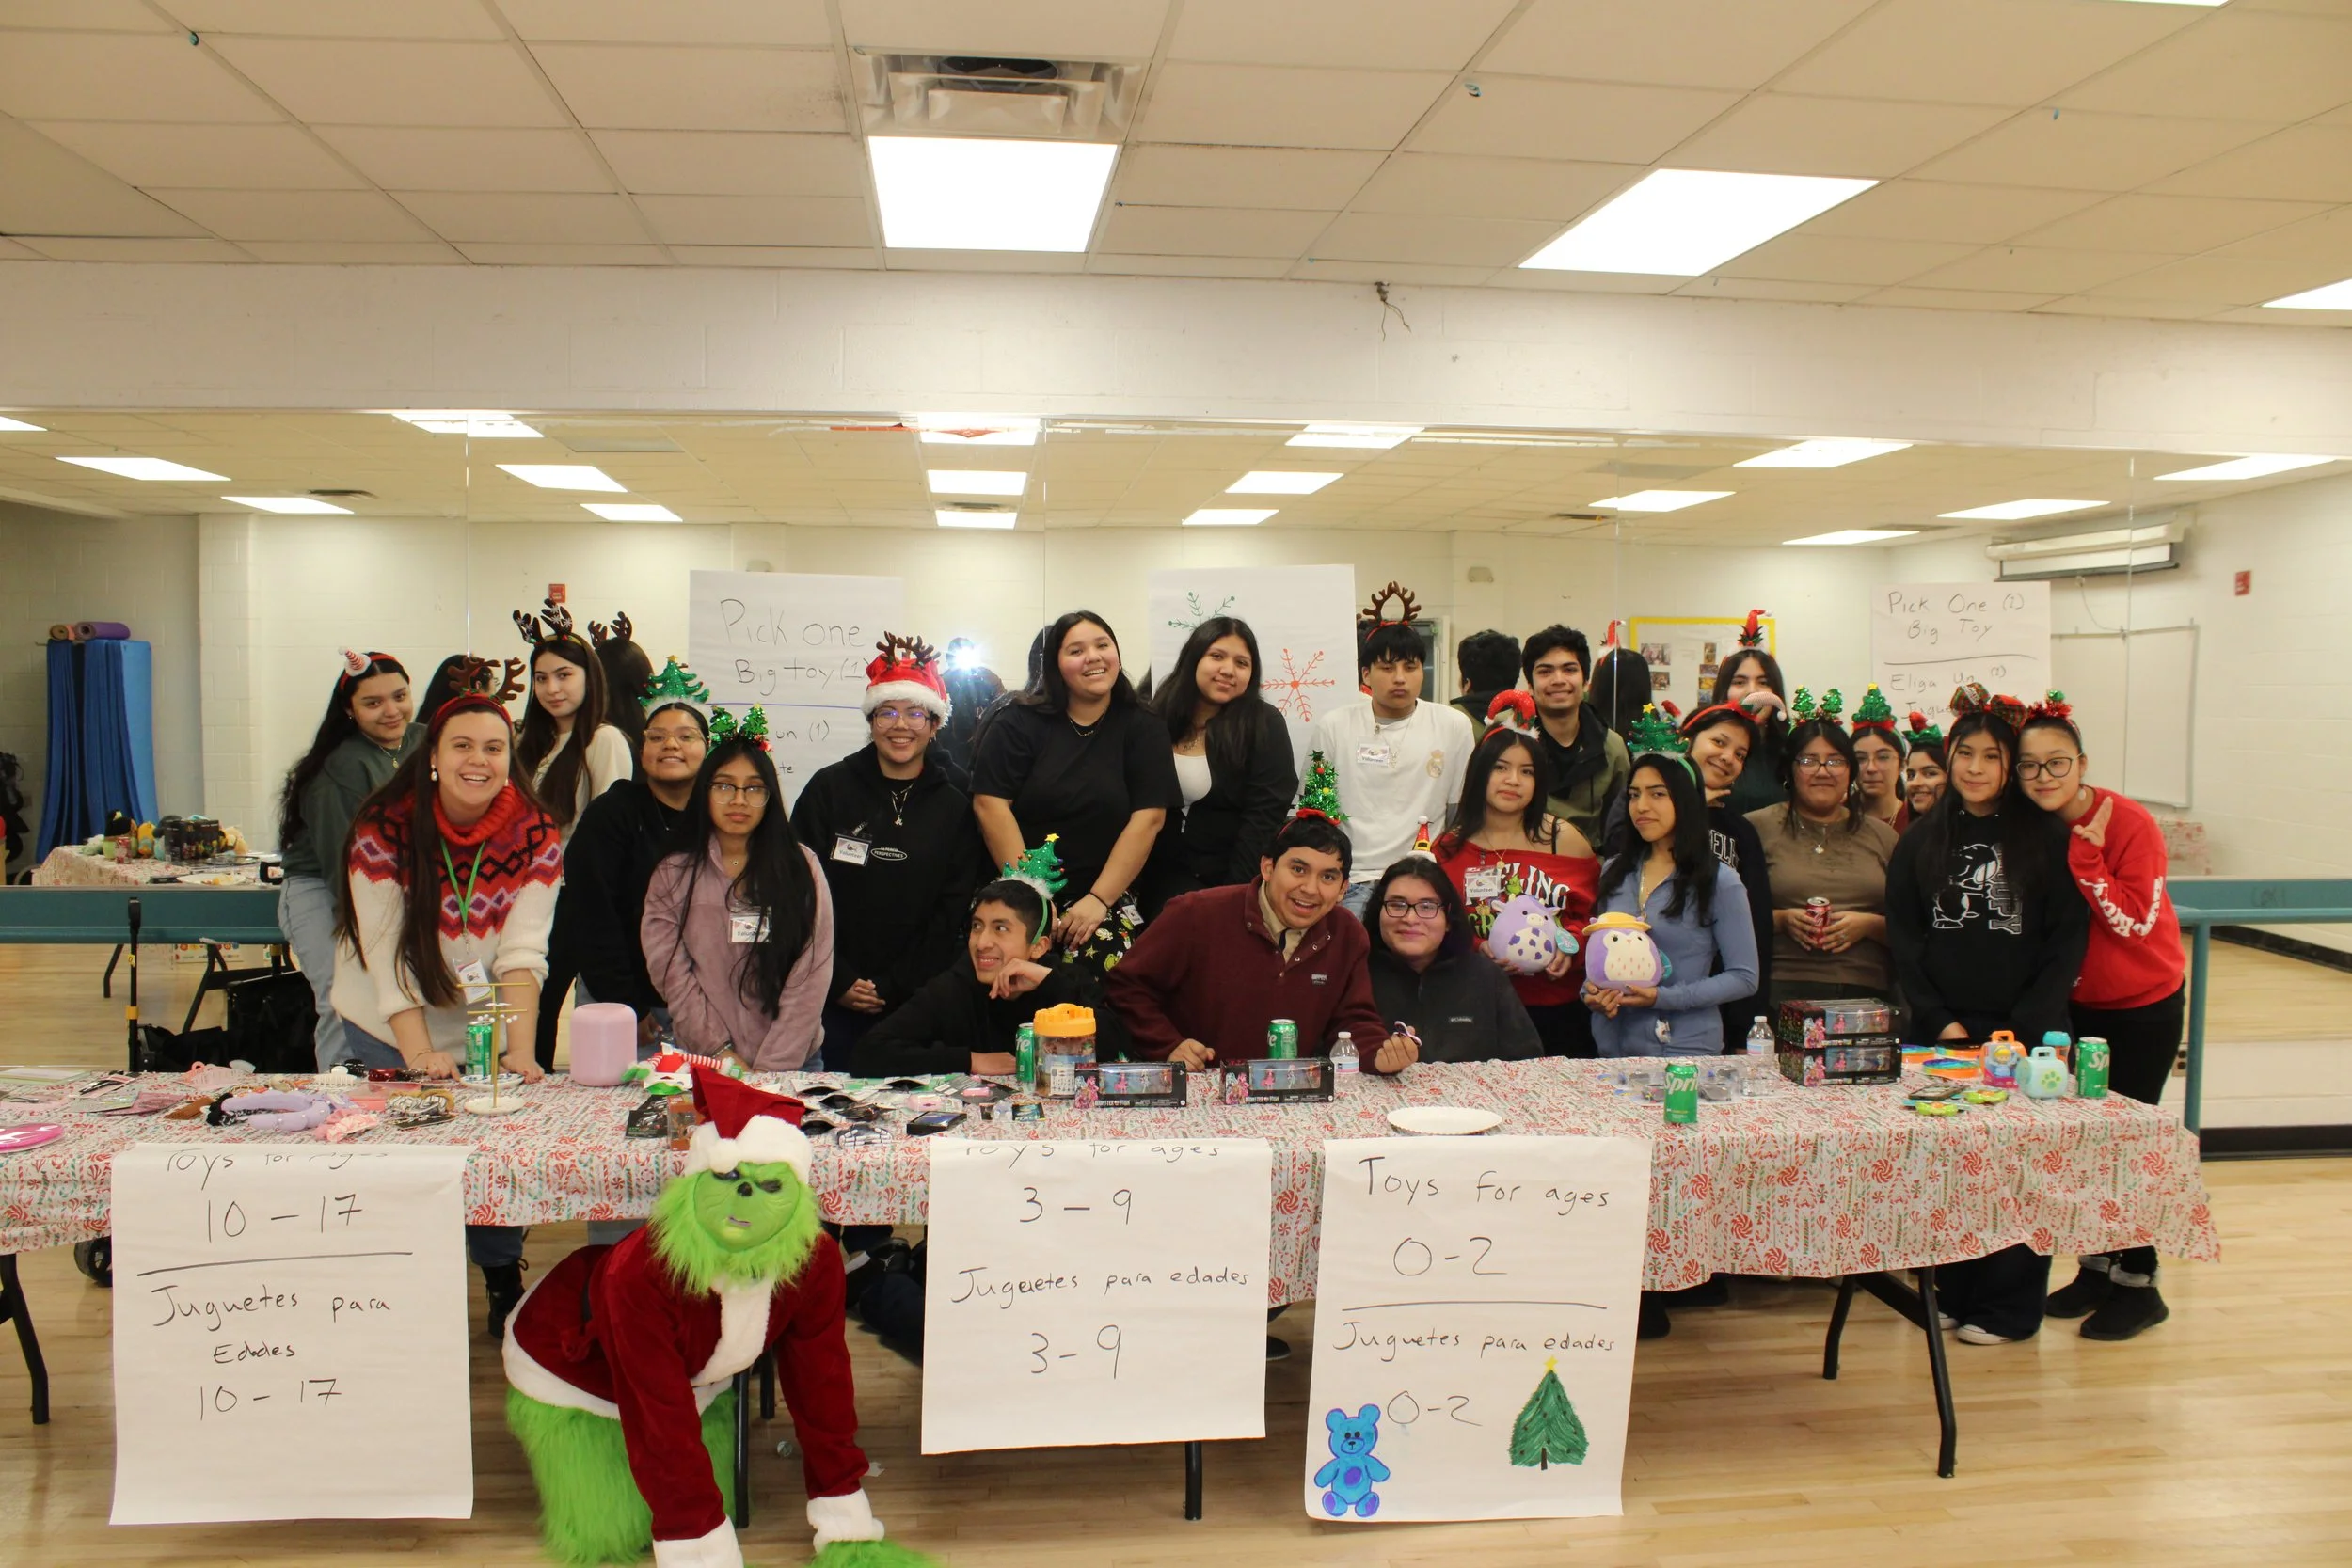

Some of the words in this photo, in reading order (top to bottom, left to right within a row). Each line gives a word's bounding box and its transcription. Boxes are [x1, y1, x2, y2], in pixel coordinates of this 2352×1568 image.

[1888, 591, 1930, 613] Pick
[1948, 593, 1987, 613] One
[2002, 593, 2024, 611] (1)
[720, 598, 788, 646] Pick
[802, 622, 865, 648] one
[1908, 619, 1939, 645] Big
[1959, 618, 1994, 641] Toy
[734, 658, 777, 697] Big
[783, 657, 834, 689] toy
[1889, 673, 1937, 693] Eliga
[808, 719, 830, 742] (1)
[839, 849, 863, 859] Volunteer
[1151, 1145, 1219, 1163] ages
[1019, 1186, 1043, 1223] 3
[1112, 1188, 1132, 1225] 9
[1358, 1156, 1439, 1206] Toys
[1544, 1186, 1610, 1216] ages
[208, 1199, 246, 1243] 10
[320, 1193, 363, 1234] 17
[1104, 1272, 1152, 1296] para
[1169, 1265, 1249, 1286] edades
[151, 1283, 298, 1332] Juguetes
[331, 1296, 390, 1323] para
[1332, 1321, 1460, 1362] Juguetes
[1480, 1334, 1527, 1358] para
[1543, 1332, 1615, 1352] edades
[199, 1385, 238, 1421] 10
[299, 1377, 342, 1406] 17
